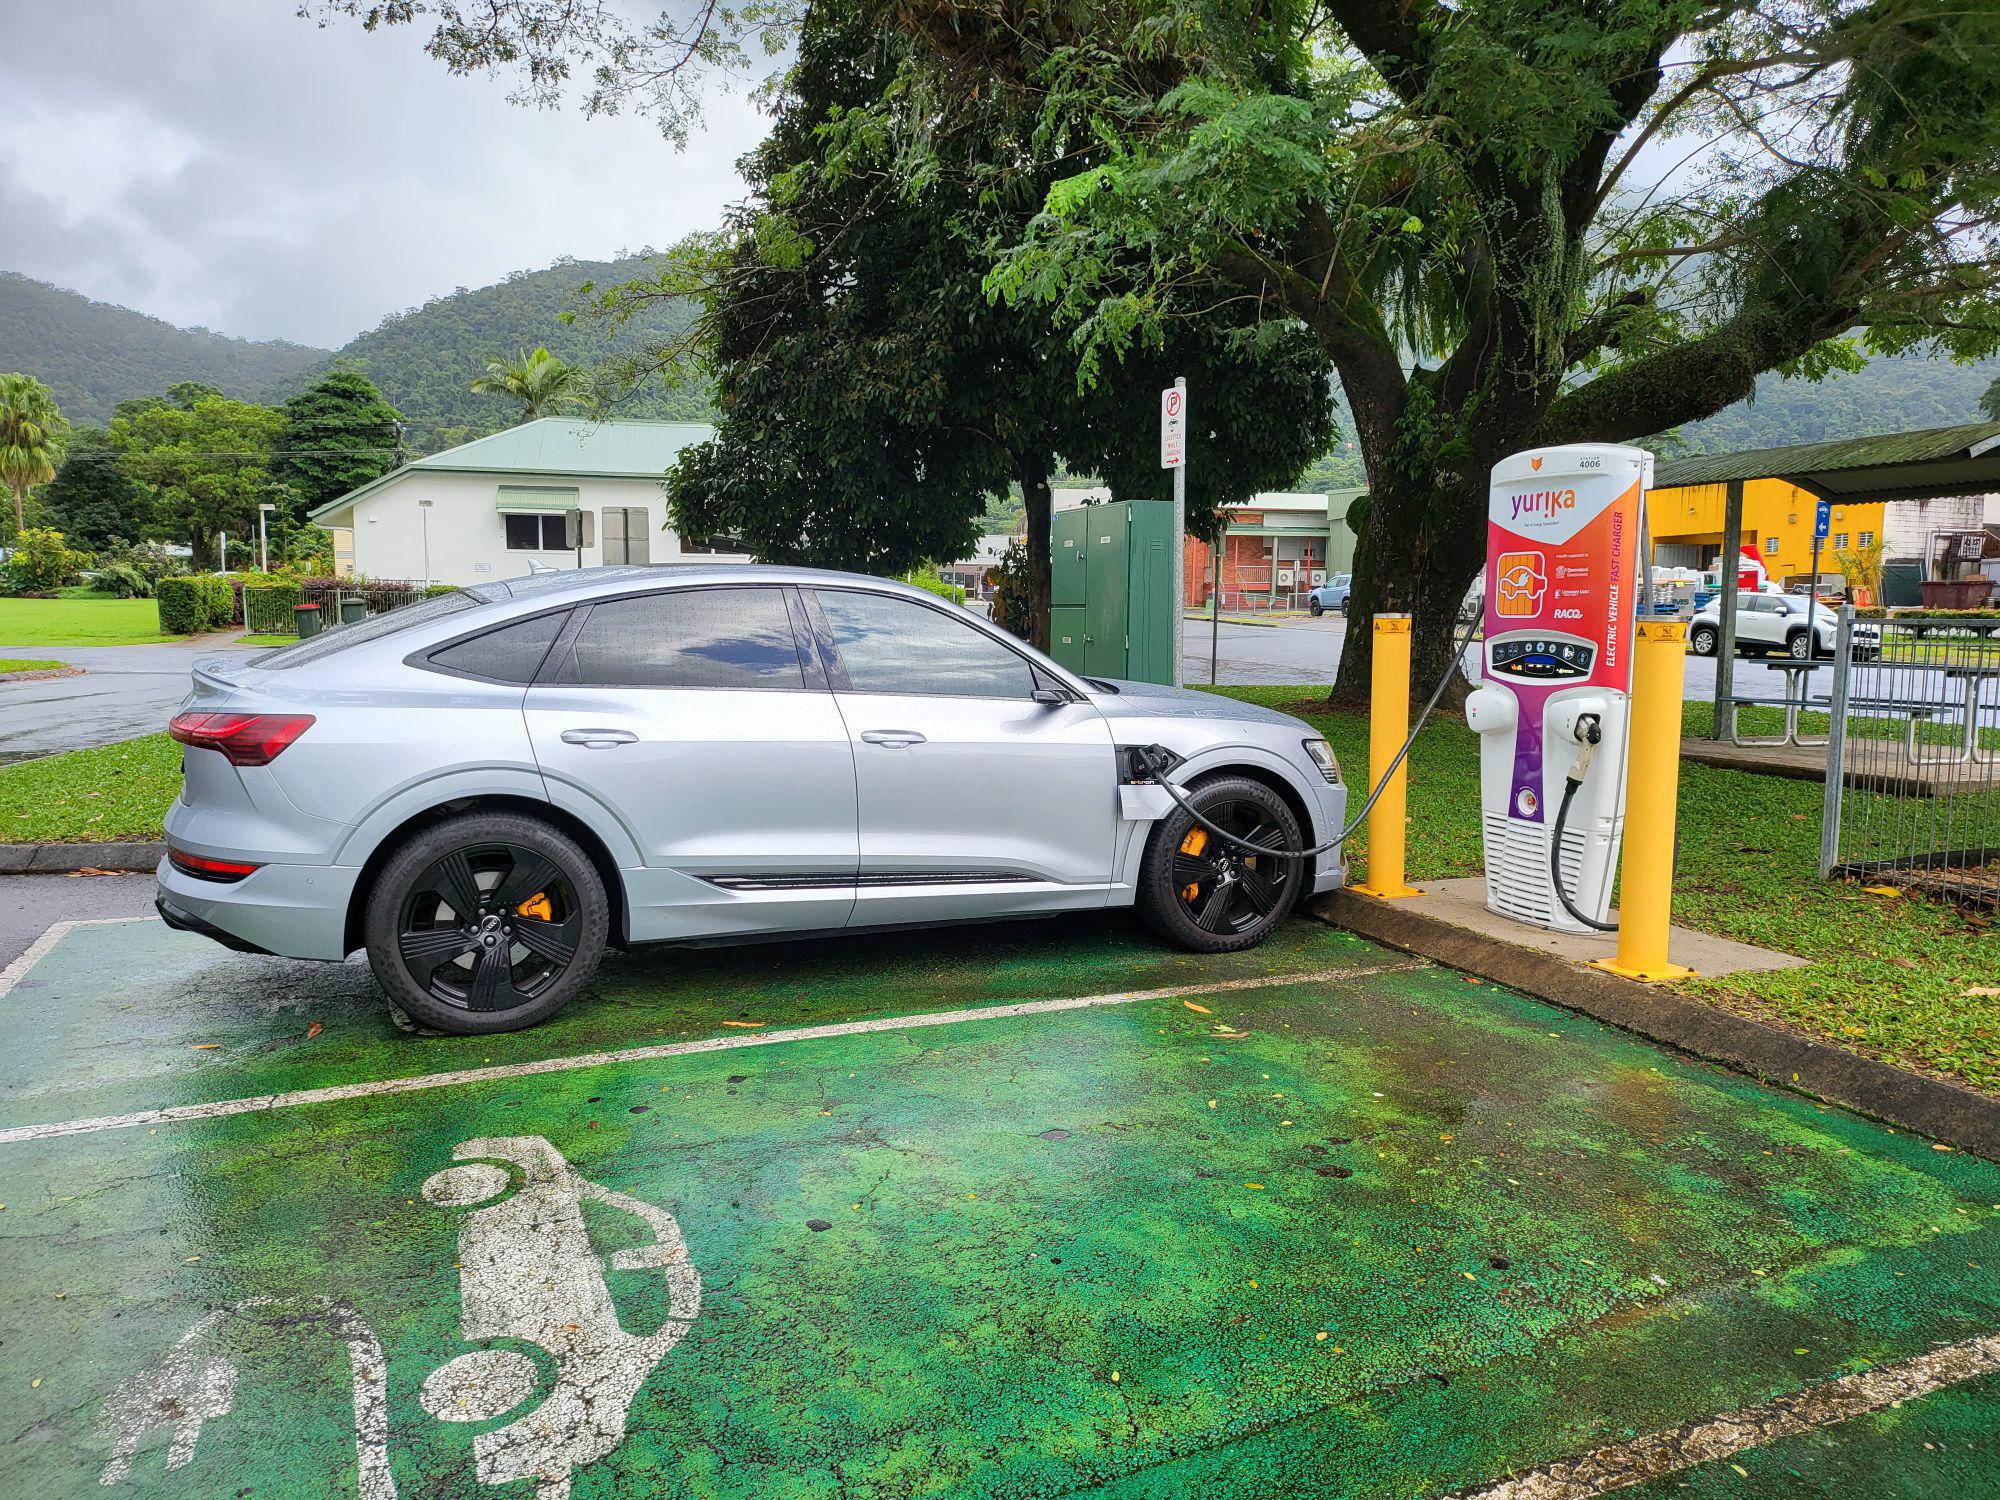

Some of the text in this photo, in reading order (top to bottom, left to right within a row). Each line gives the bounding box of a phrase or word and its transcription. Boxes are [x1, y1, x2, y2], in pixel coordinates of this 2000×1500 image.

[1579, 460, 1601, 468] 4006
[1605, 511, 1623, 667] ELECTRIC VEHICLE FAST CHARGER
[1553, 608, 1584, 619] RACQ
